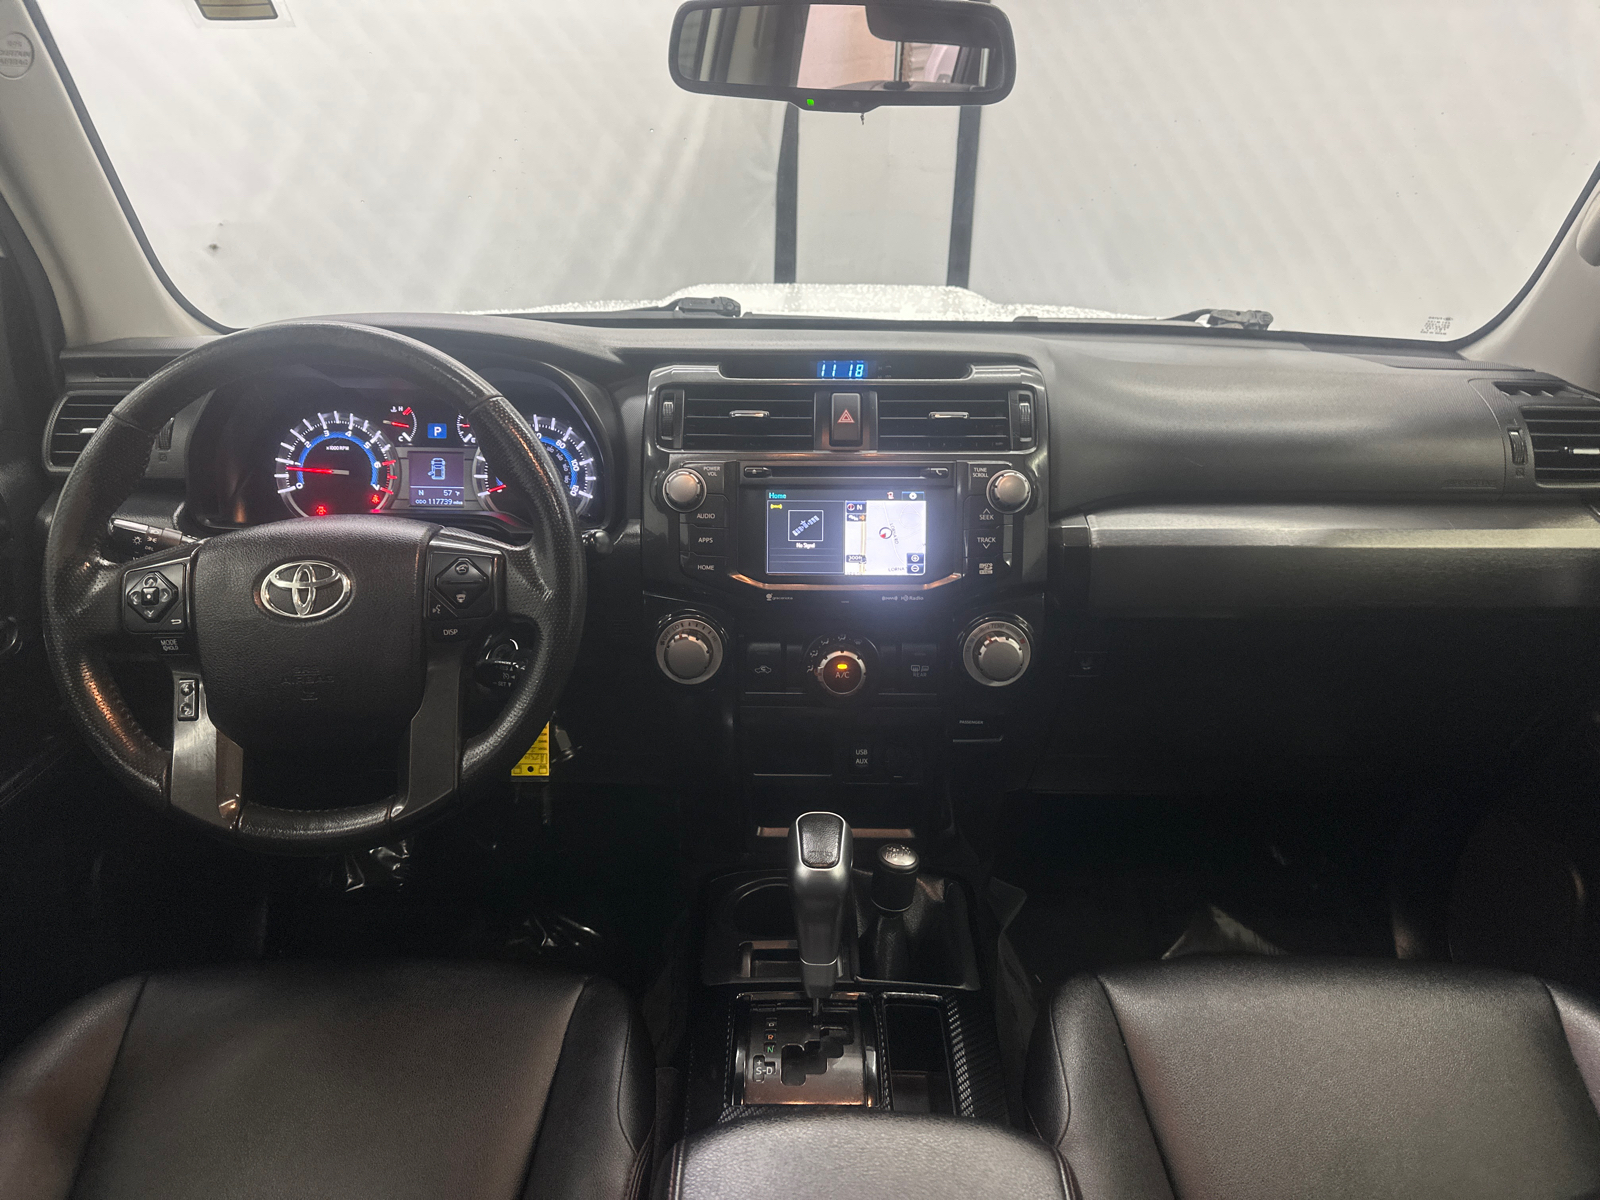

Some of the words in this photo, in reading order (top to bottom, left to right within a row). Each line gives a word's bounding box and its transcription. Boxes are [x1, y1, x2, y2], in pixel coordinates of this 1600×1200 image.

[433, 426, 442, 437] P
[303, 441, 311, 449] 2
[555, 440, 566, 449] 80
[571, 459, 580, 471] 100
[443, 628, 459, 636] DISP
[835, 671, 850, 679] A/C
